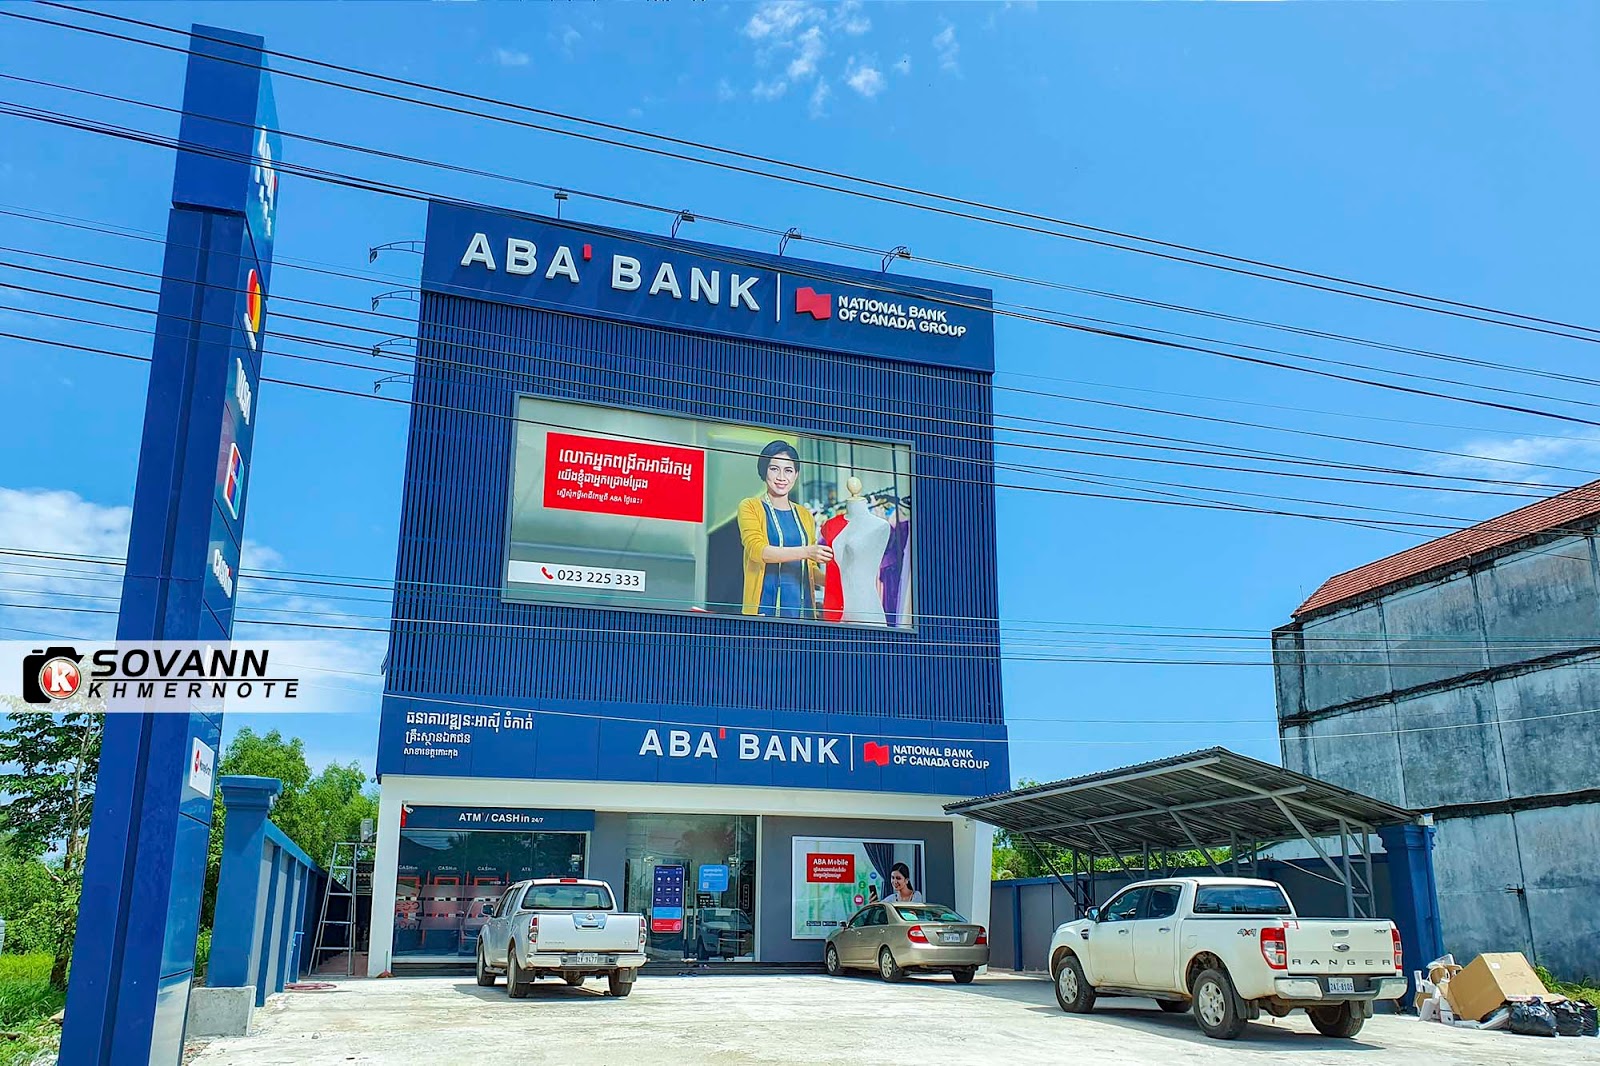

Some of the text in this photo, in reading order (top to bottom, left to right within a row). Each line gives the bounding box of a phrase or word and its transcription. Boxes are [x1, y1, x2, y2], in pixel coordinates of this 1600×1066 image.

[611, 253, 761, 312] BANK
[838, 294, 948, 323] NATIONAL BANK
[839, 307, 967, 338] OF CANADA GROUP
[609, 494, 622, 503] ABA
[557, 569, 640, 586] 023 225 333
[739, 733, 840, 764] BANK
[892, 744, 974, 759] NATIONAL BANK
[892, 755, 990, 769] OF CANADA GROUP
[458, 812, 482, 822] ATM
